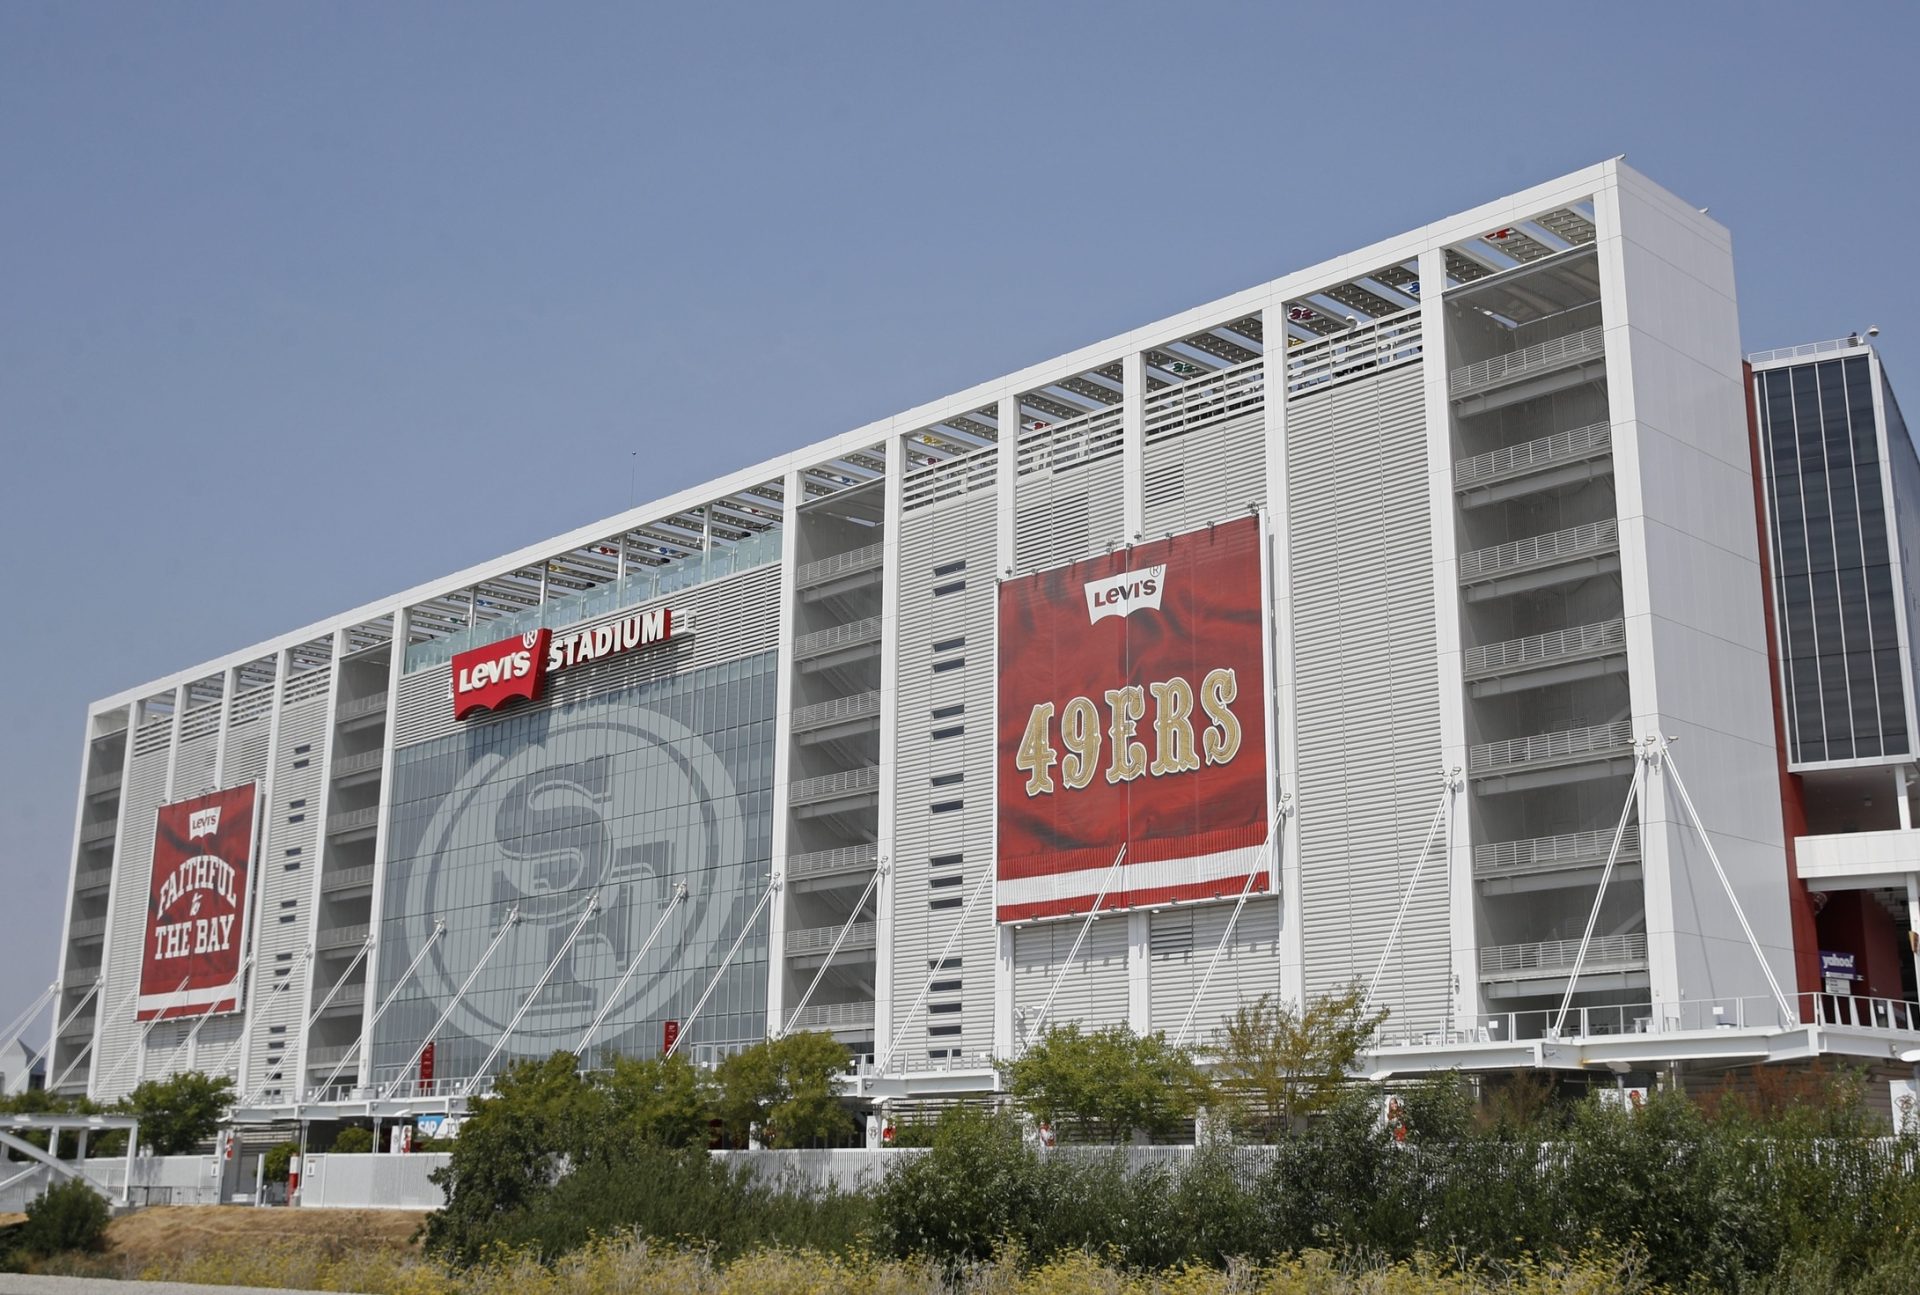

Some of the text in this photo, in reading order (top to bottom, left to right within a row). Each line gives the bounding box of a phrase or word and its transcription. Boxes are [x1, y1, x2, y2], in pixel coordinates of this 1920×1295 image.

[547, 609, 665, 672] STADIUM
[1016, 668, 1241, 797] 49ERS
[157, 855, 237, 920] FAITHFUL
[155, 914, 236, 960] THE BAY
